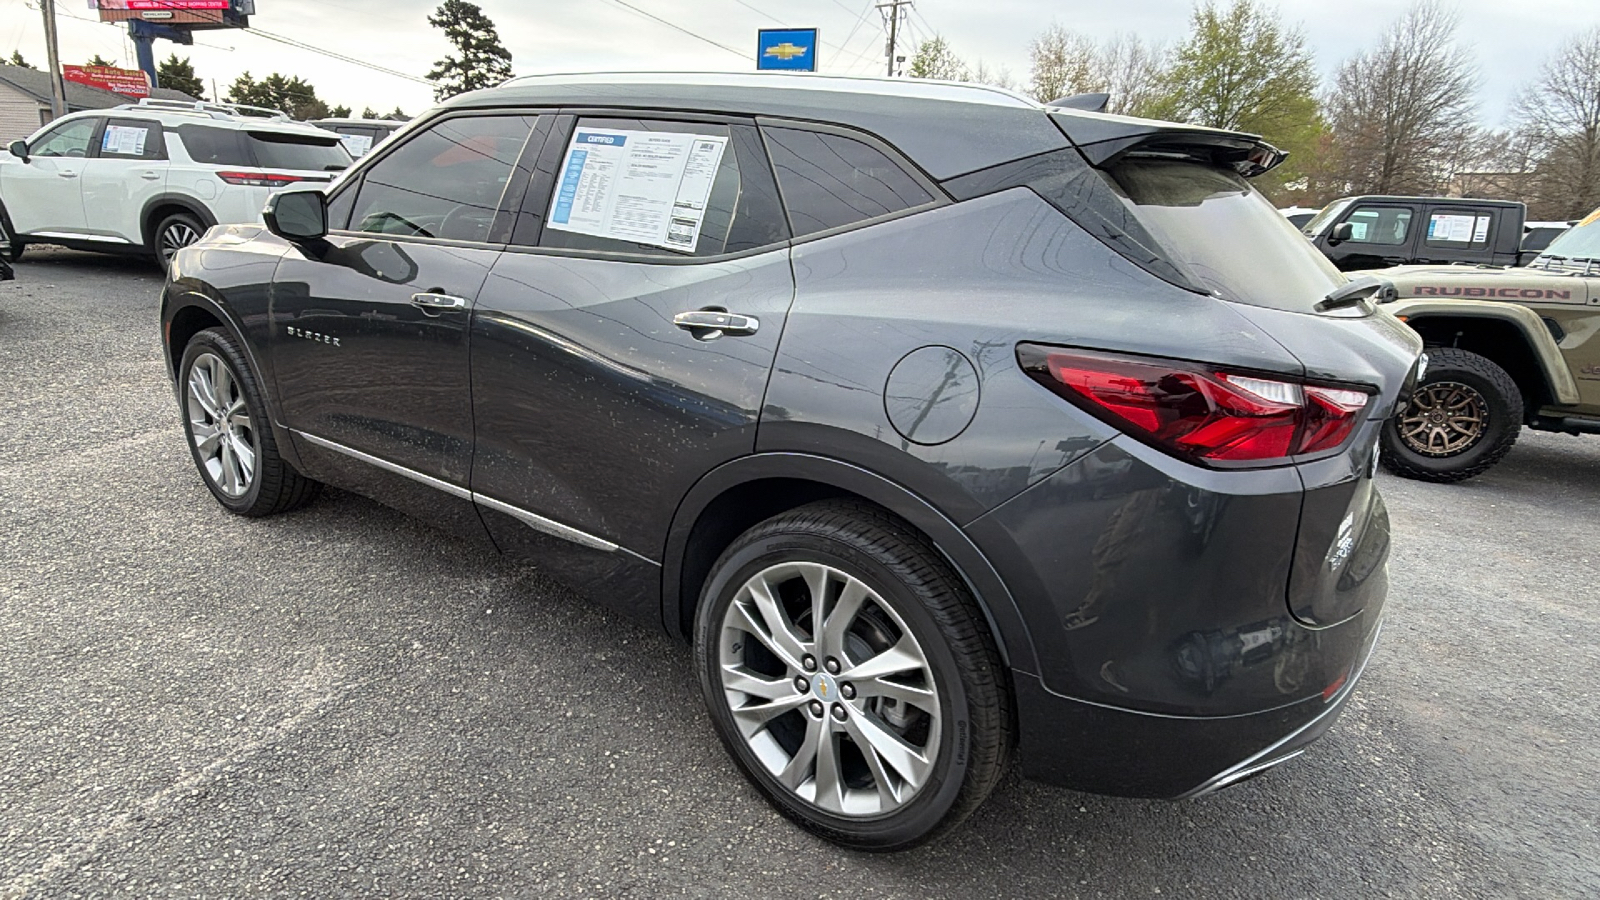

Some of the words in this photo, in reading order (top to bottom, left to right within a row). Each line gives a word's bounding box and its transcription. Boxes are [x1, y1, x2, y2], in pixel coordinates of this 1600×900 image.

[587, 135, 614, 144] CERTIFIED
[1413, 286, 1571, 300] RUBICON
[287, 326, 341, 347] BLAZER
